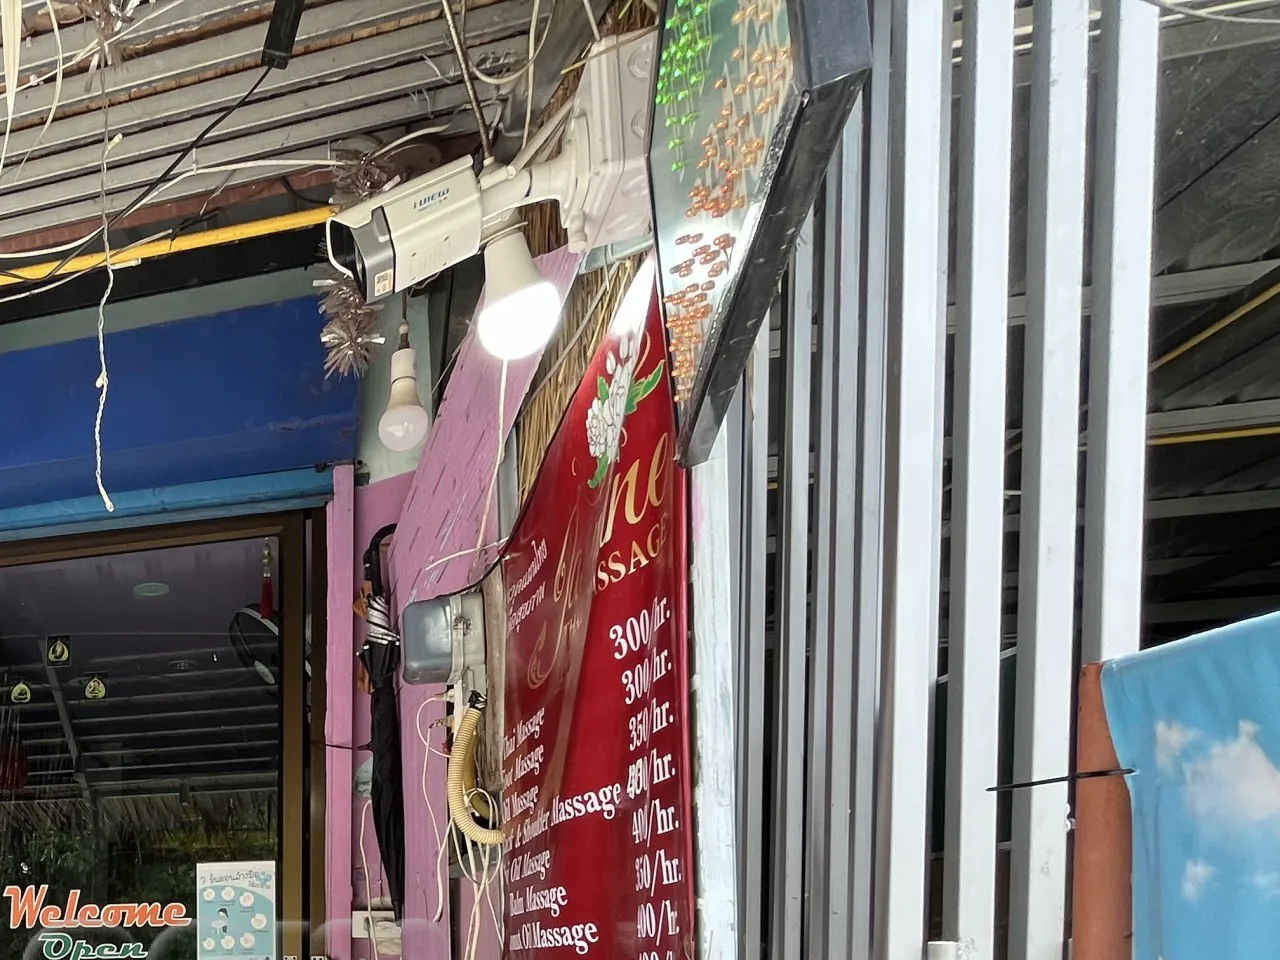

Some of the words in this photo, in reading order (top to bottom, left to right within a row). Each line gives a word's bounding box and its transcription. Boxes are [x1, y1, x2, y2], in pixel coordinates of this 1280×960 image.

[593, 512, 669, 596] SSAGE
[609, 596, 671, 660] 300/hr.
[622, 647, 672, 705] 300/hr.
[629, 698, 674, 751] 350/hr.
[551, 782, 621, 826] Massage
[3, 885, 192, 929] Welcome
[526, 885, 568, 917] Massage
[532, 922, 599, 955] Massage
